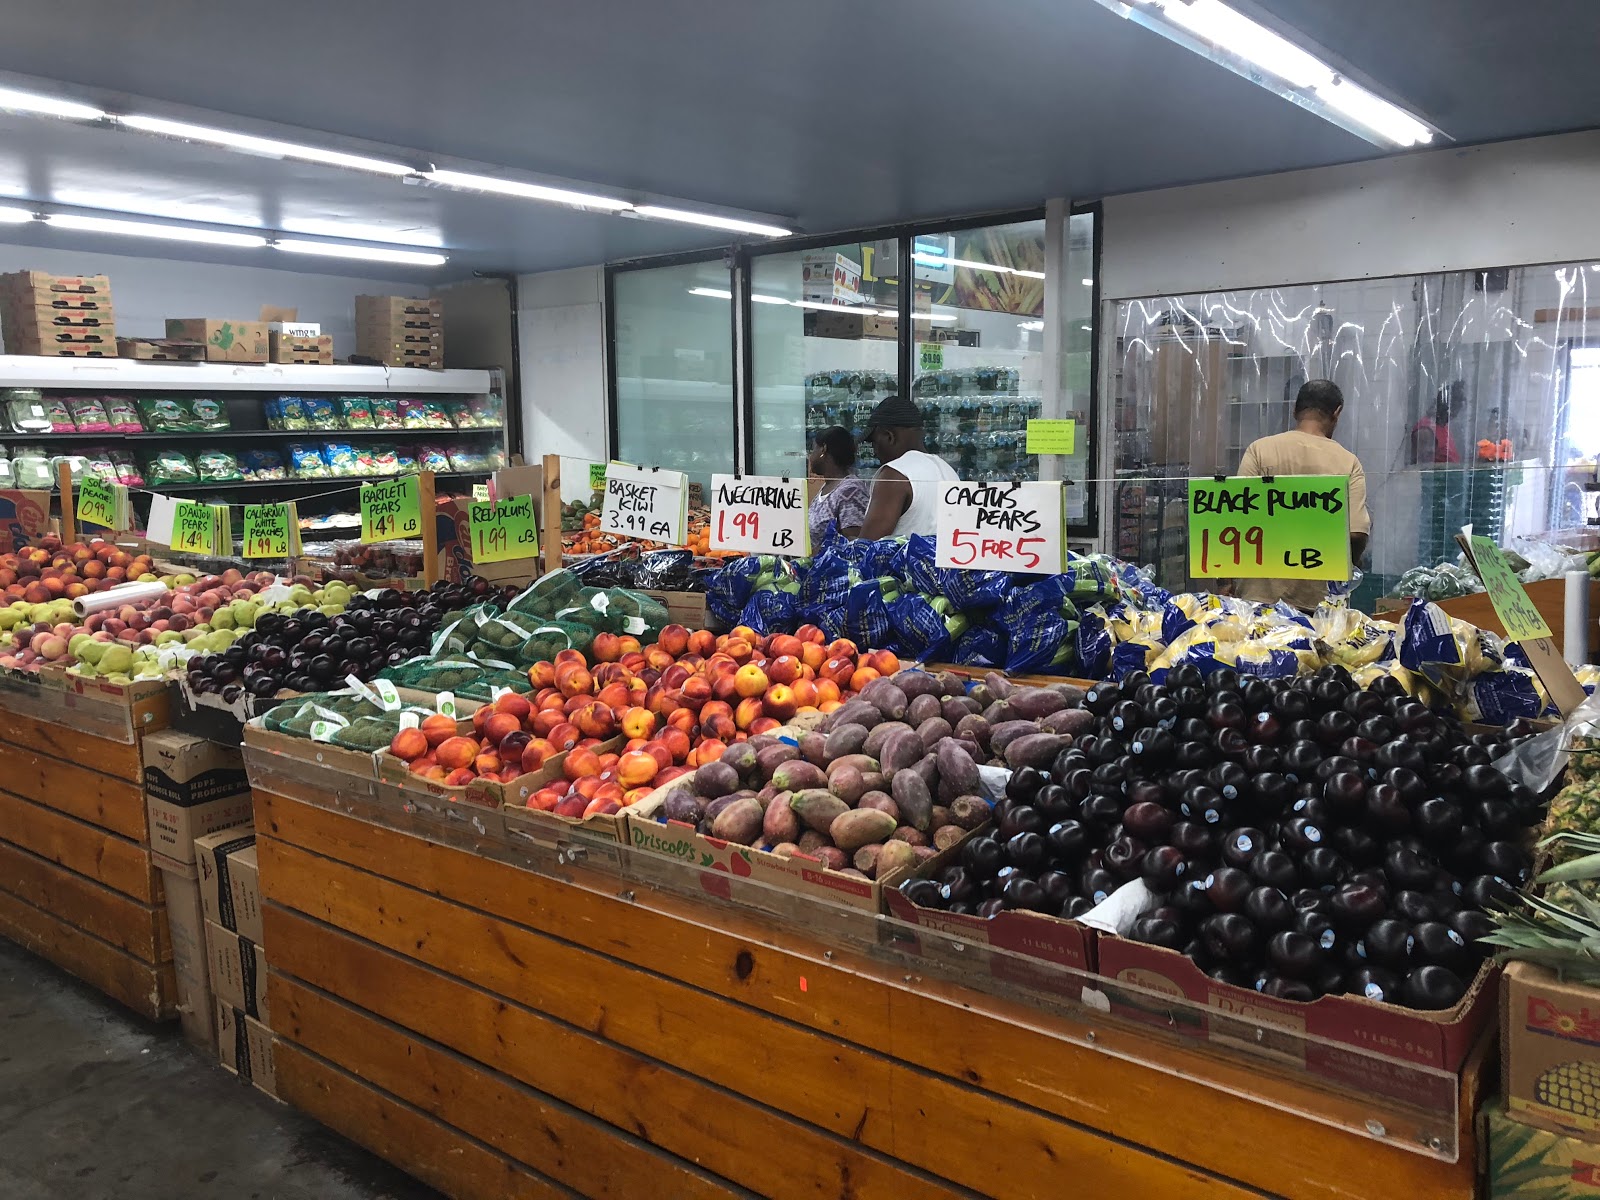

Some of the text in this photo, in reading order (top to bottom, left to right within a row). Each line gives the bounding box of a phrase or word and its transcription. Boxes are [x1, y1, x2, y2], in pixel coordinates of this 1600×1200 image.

[362, 482, 407, 504] BARTLETT
[609, 479, 658, 501] BASKET
[718, 483, 803, 510] NECTARINE
[944, 486, 1018, 509] CACTUS
[81, 500, 105, 518] 0.99
[245, 506, 286, 519] CALIFORNIA
[369, 500, 401, 518] PEARS
[619, 498, 654, 514] KIWI
[1193, 486, 1343, 517] BLACK PLUMS
[255, 518, 277, 528] WHITE
[472, 502, 532, 525] RED PLUMS
[609, 510, 671, 539] 3.99 EA
[976, 508, 1042, 534] PEARS
[181, 518, 208, 532] PEARS
[250, 527, 284, 538] PEACHES
[369, 514, 417, 539] 1.49 LB
[717, 510, 794, 549] 1.99 LB
[180, 530, 203, 550] 1.49
[248, 537, 287, 556] 1.99 LB
[479, 528, 535, 556] 1.99 LB
[950, 528, 1047, 569] 5 FOR 5
[1201, 525, 1324, 574] 1.99 LB
[191, 780, 249, 800] PRODUCE RO
[632, 826, 698, 861] Driscoll's
[756, 858, 799, 876] Strawberries
